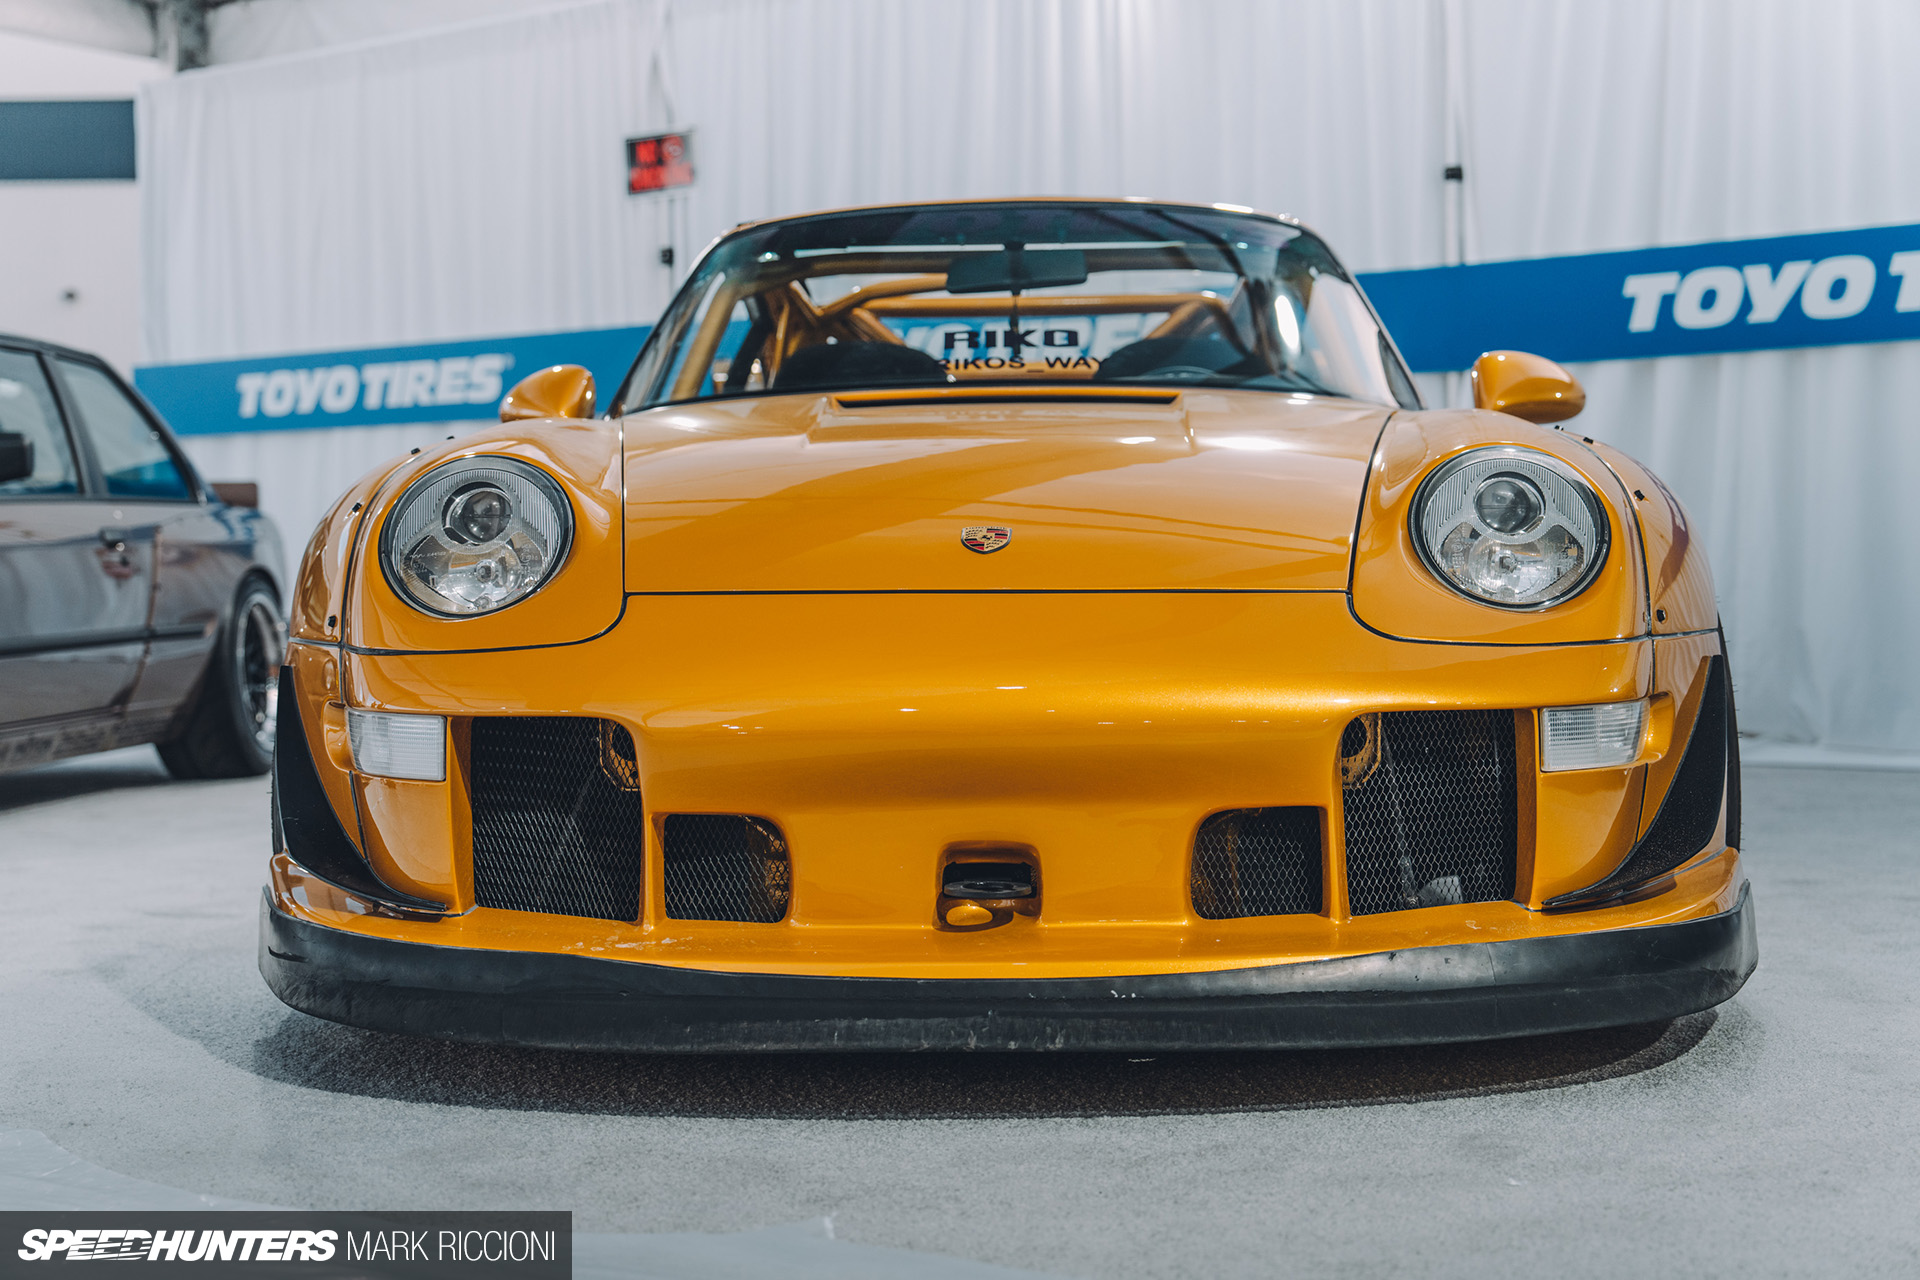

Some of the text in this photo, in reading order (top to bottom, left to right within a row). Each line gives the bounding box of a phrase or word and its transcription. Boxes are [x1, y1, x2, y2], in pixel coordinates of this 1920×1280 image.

[1622, 254, 1877, 333] TOYO
[944, 329, 1079, 349] RIKO
[236, 353, 504, 419] TOYO TIRES
